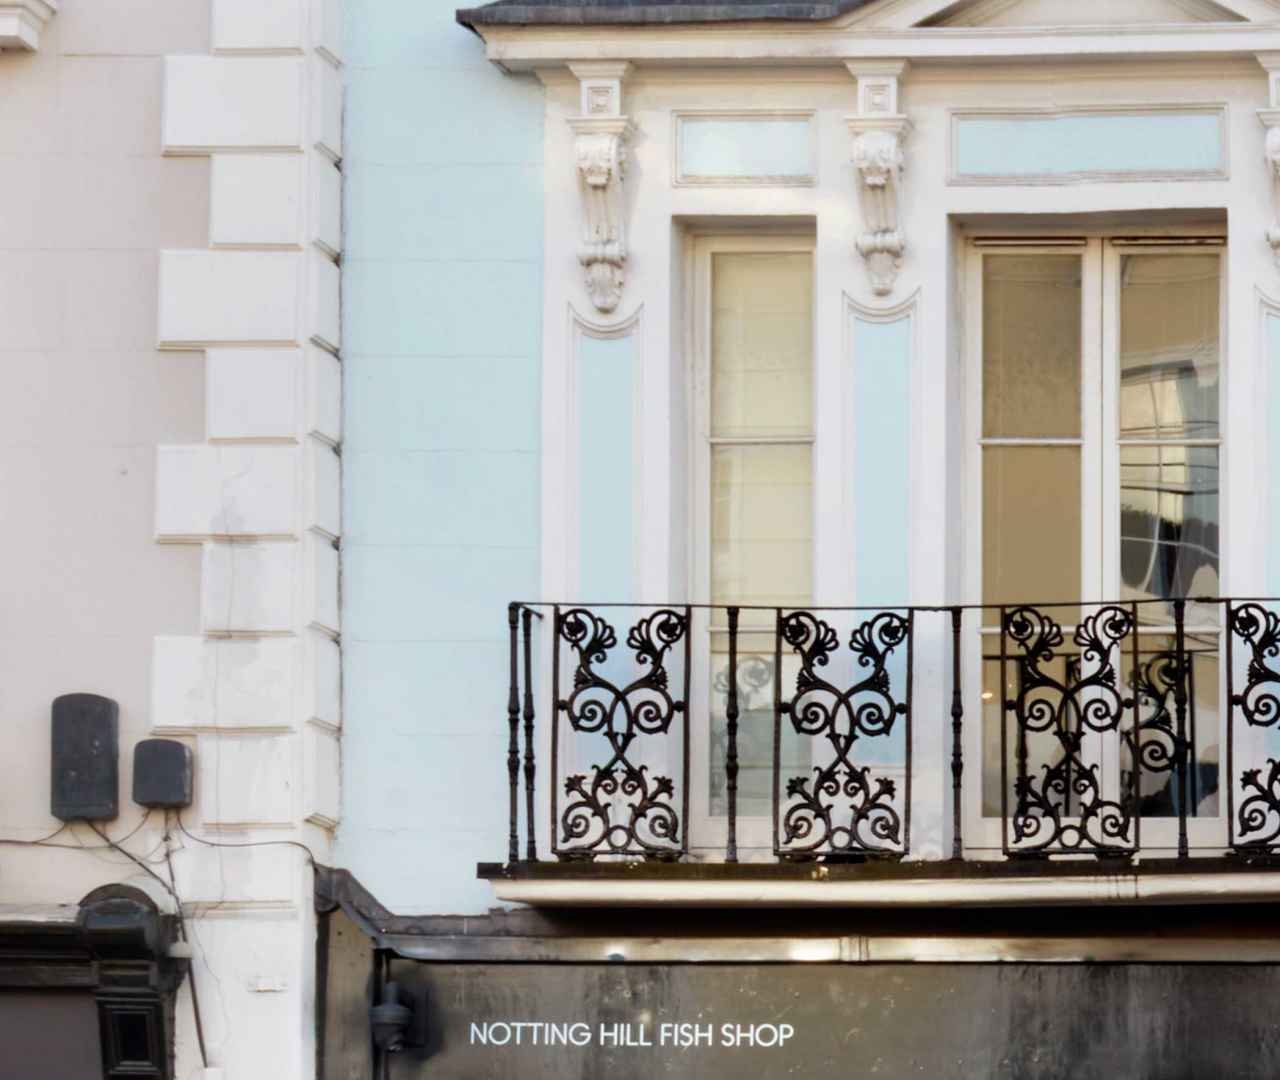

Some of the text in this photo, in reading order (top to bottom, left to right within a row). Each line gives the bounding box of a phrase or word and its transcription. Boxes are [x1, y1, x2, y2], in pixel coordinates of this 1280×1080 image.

[469, 1021, 795, 1048] NOTTING HILL FISH SHOP
